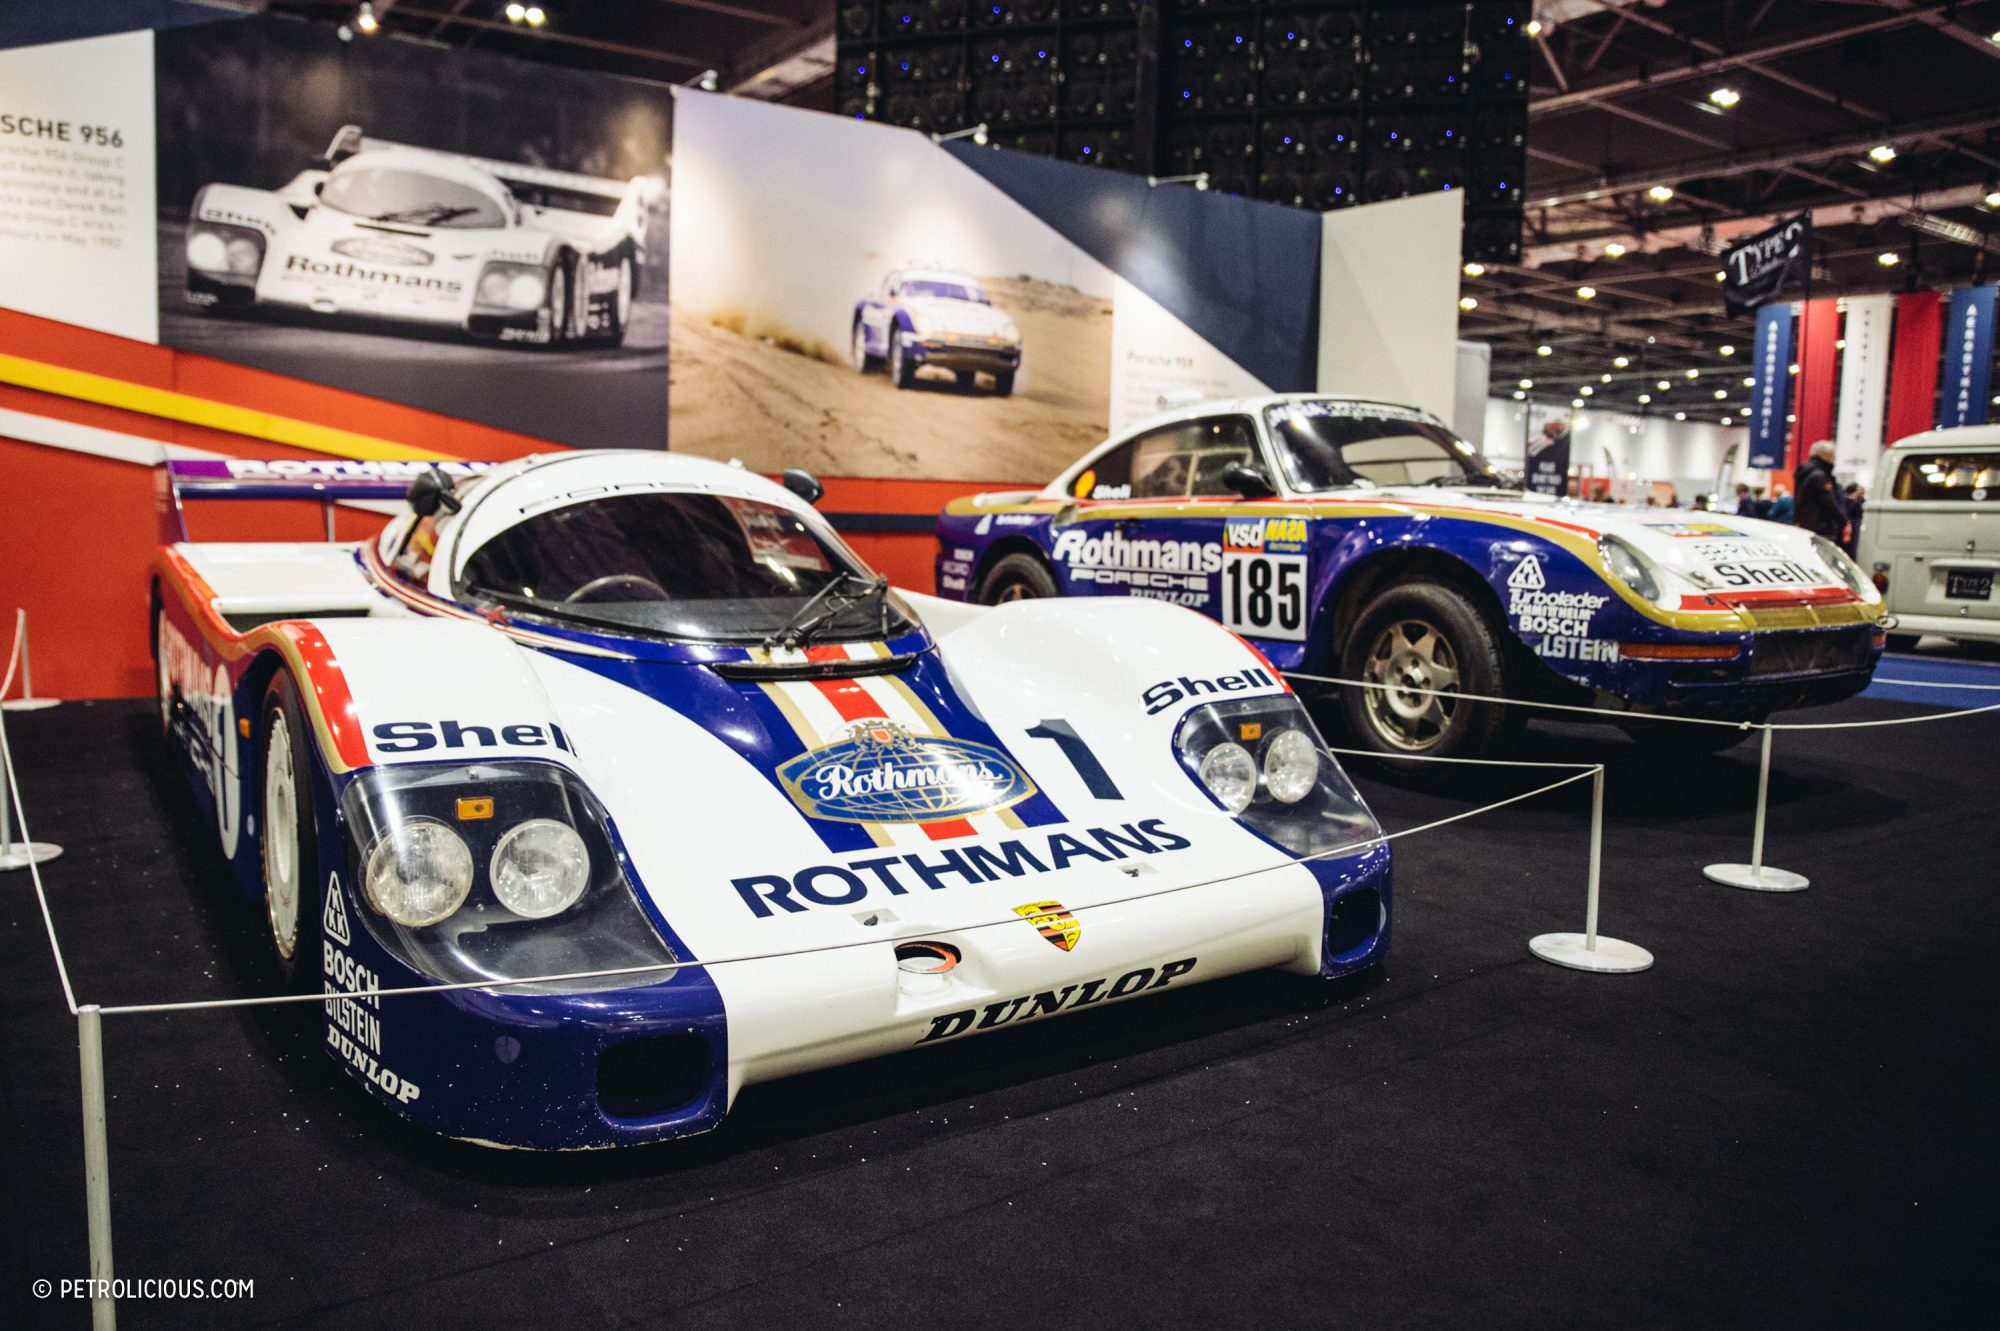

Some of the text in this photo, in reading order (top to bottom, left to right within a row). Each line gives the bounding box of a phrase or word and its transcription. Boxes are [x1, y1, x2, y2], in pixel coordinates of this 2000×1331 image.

[0, 114, 124, 148] SCHE 956
[286, 254, 462, 292] Rothmans
[1052, 529, 1223, 574] Rothmans
[1713, 562, 1817, 587] Shell
[1070, 568, 1209, 592] PORSCHE
[1226, 558, 1301, 631] 185
[1518, 614, 1589, 638] BOSCH
[1140, 668, 1275, 716] Shell
[814, 761, 1005, 801] Rothmans
[1024, 718, 1125, 801] 1
[730, 817, 1192, 920] ROTHMANS
[323, 938, 381, 1011] BOSCH
[323, 978, 382, 1057] BILSTEIN
[913, 956, 1199, 1046] DUNLOP
[327, 1022, 421, 1105] DUNLOP
